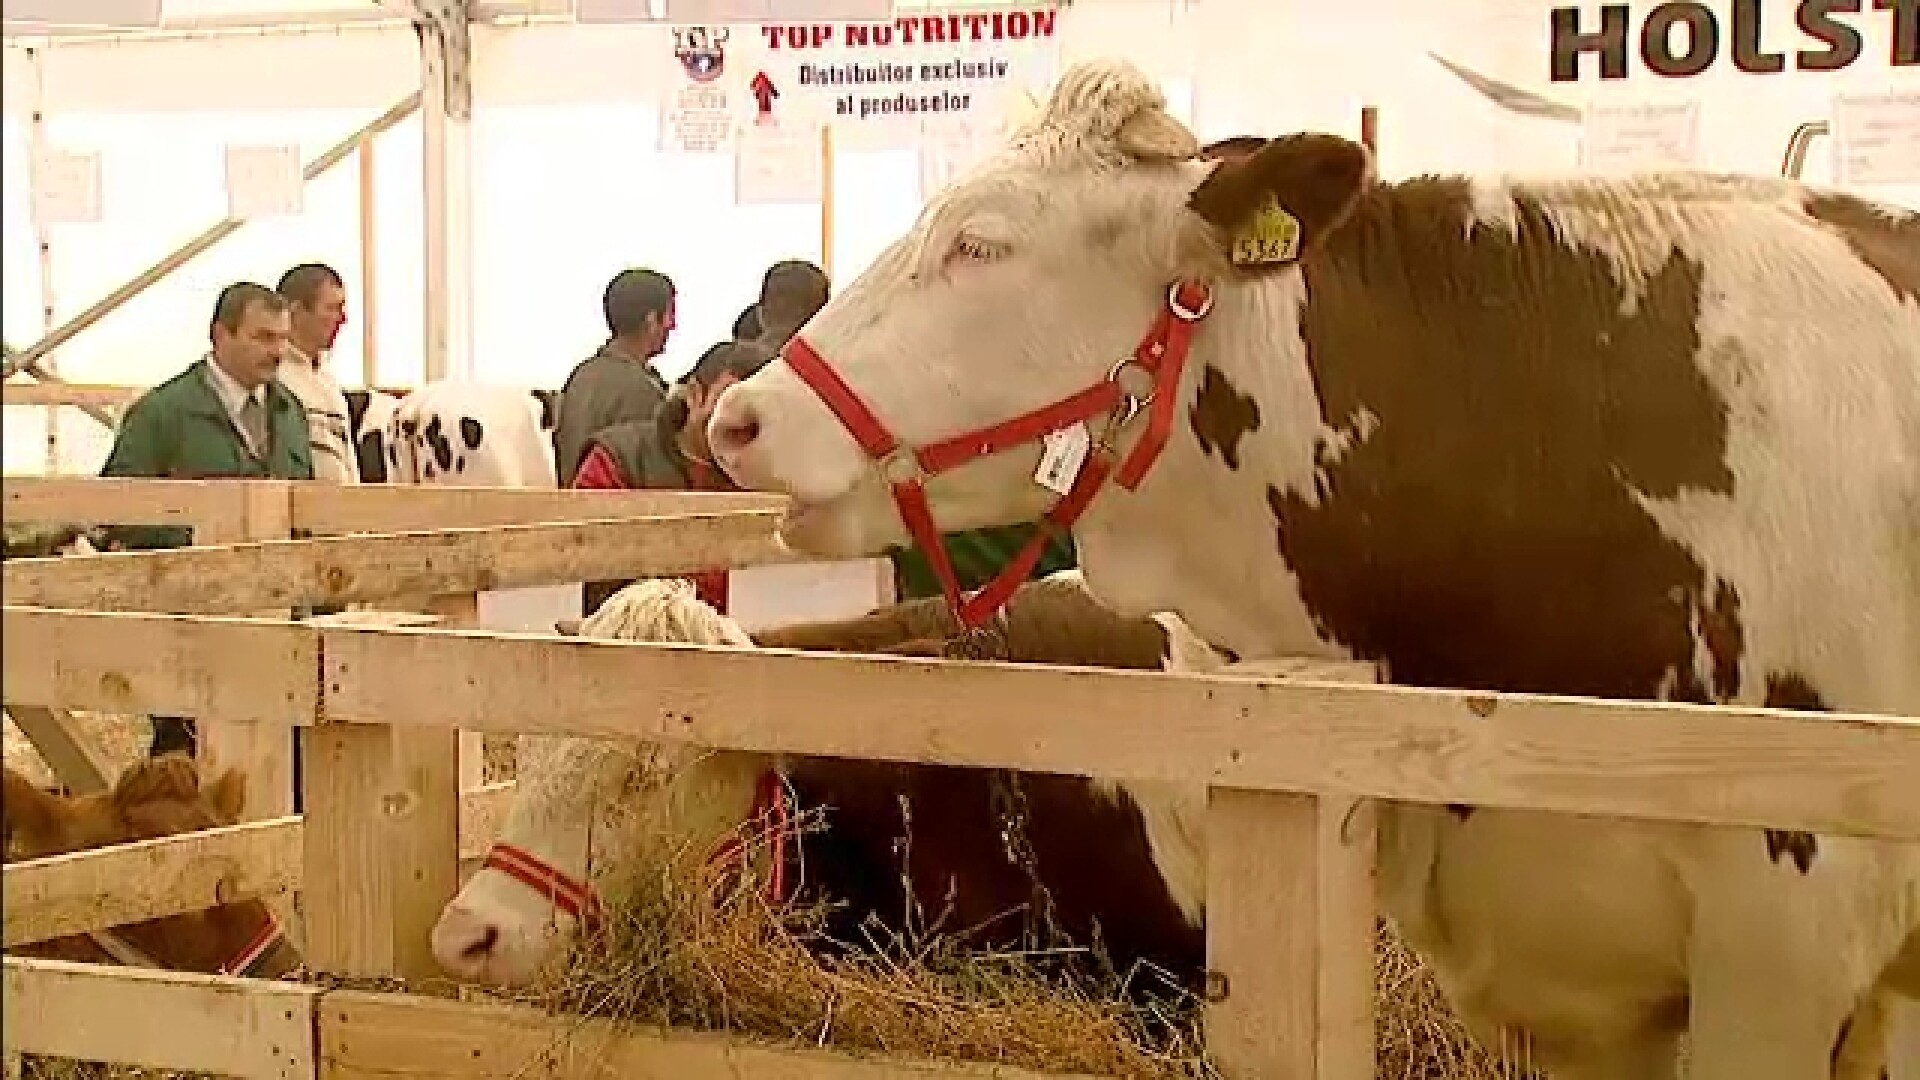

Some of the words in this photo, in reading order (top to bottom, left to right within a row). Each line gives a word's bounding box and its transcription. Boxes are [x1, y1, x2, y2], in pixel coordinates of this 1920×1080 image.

[761, 25, 832, 49] TOP
[845, 11, 1056, 46] NUTRITION
[799, 63, 913, 85] Distribuitor
[920, 57, 1009, 81] exclusiv
[836, 94, 853, 115] al
[860, 90, 971, 120] produselor
